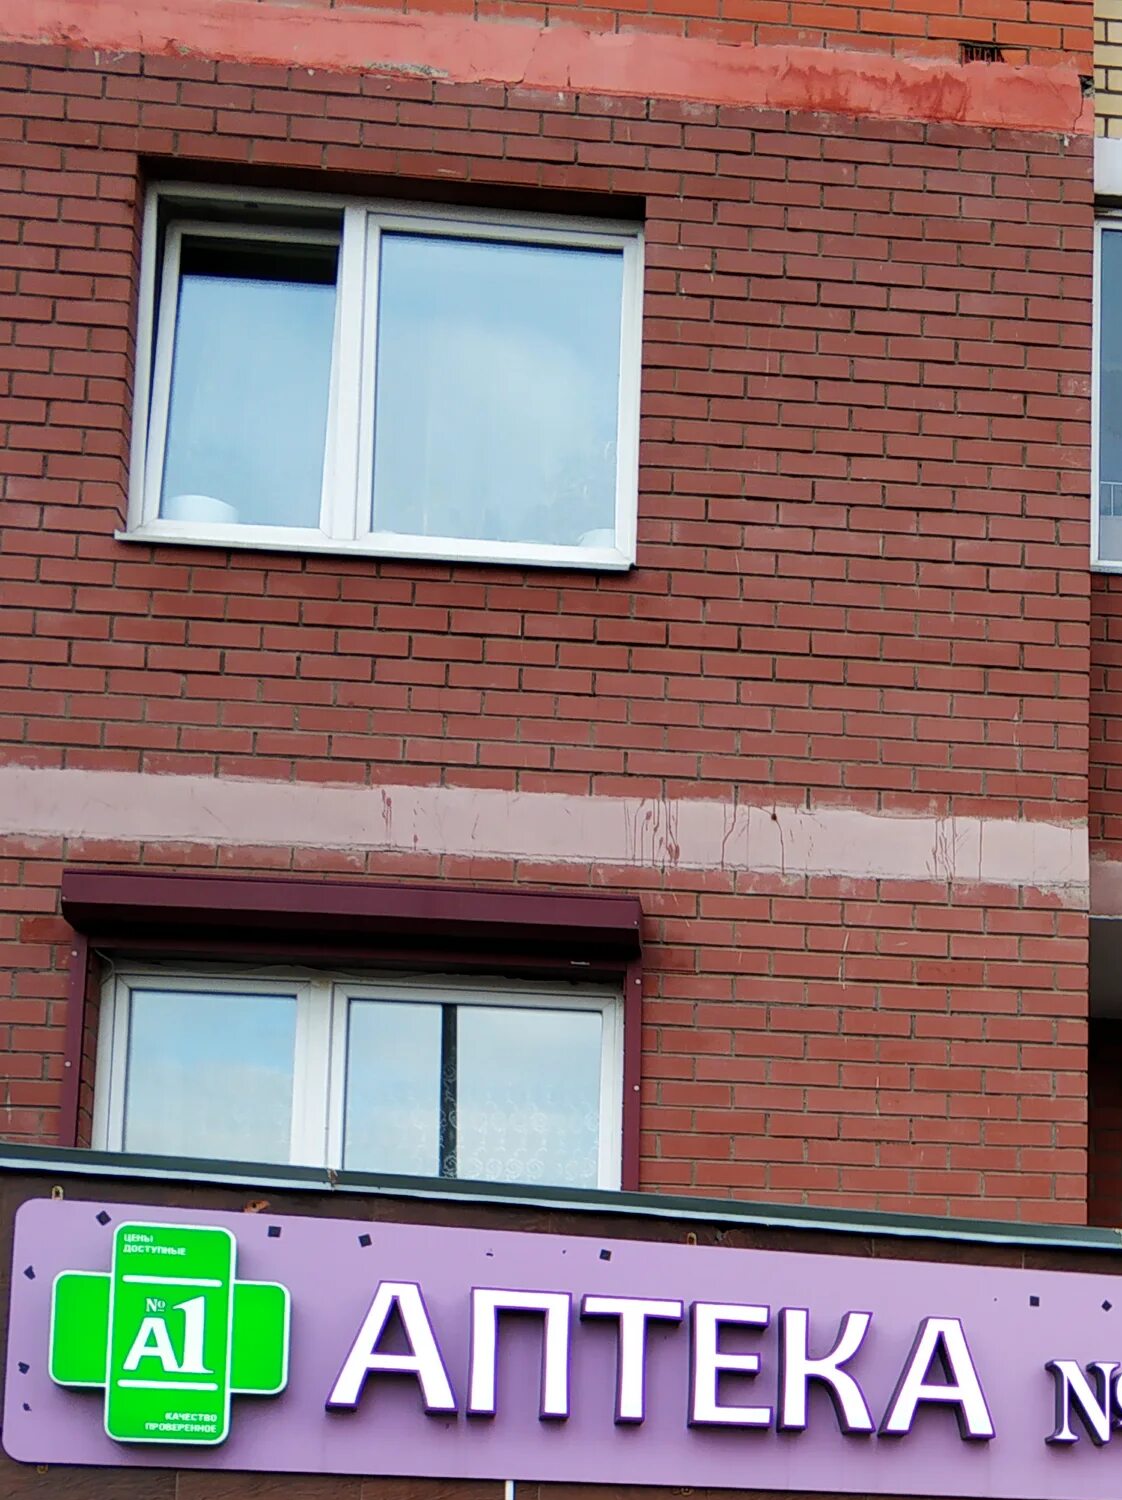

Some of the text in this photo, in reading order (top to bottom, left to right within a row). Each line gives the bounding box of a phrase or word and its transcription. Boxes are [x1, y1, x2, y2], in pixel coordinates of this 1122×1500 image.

[123, 1233, 154, 1243] ЦЕНЫ
[122, 1244, 187, 1256] ДОСТУПНЫЕ
[325, 1281, 996, 1441] АПТЕКА
[165, 1412, 218, 1423] КАЧЕСТВО
[144, 1422, 217, 1433] ПРОВЕРЕННОЕ
